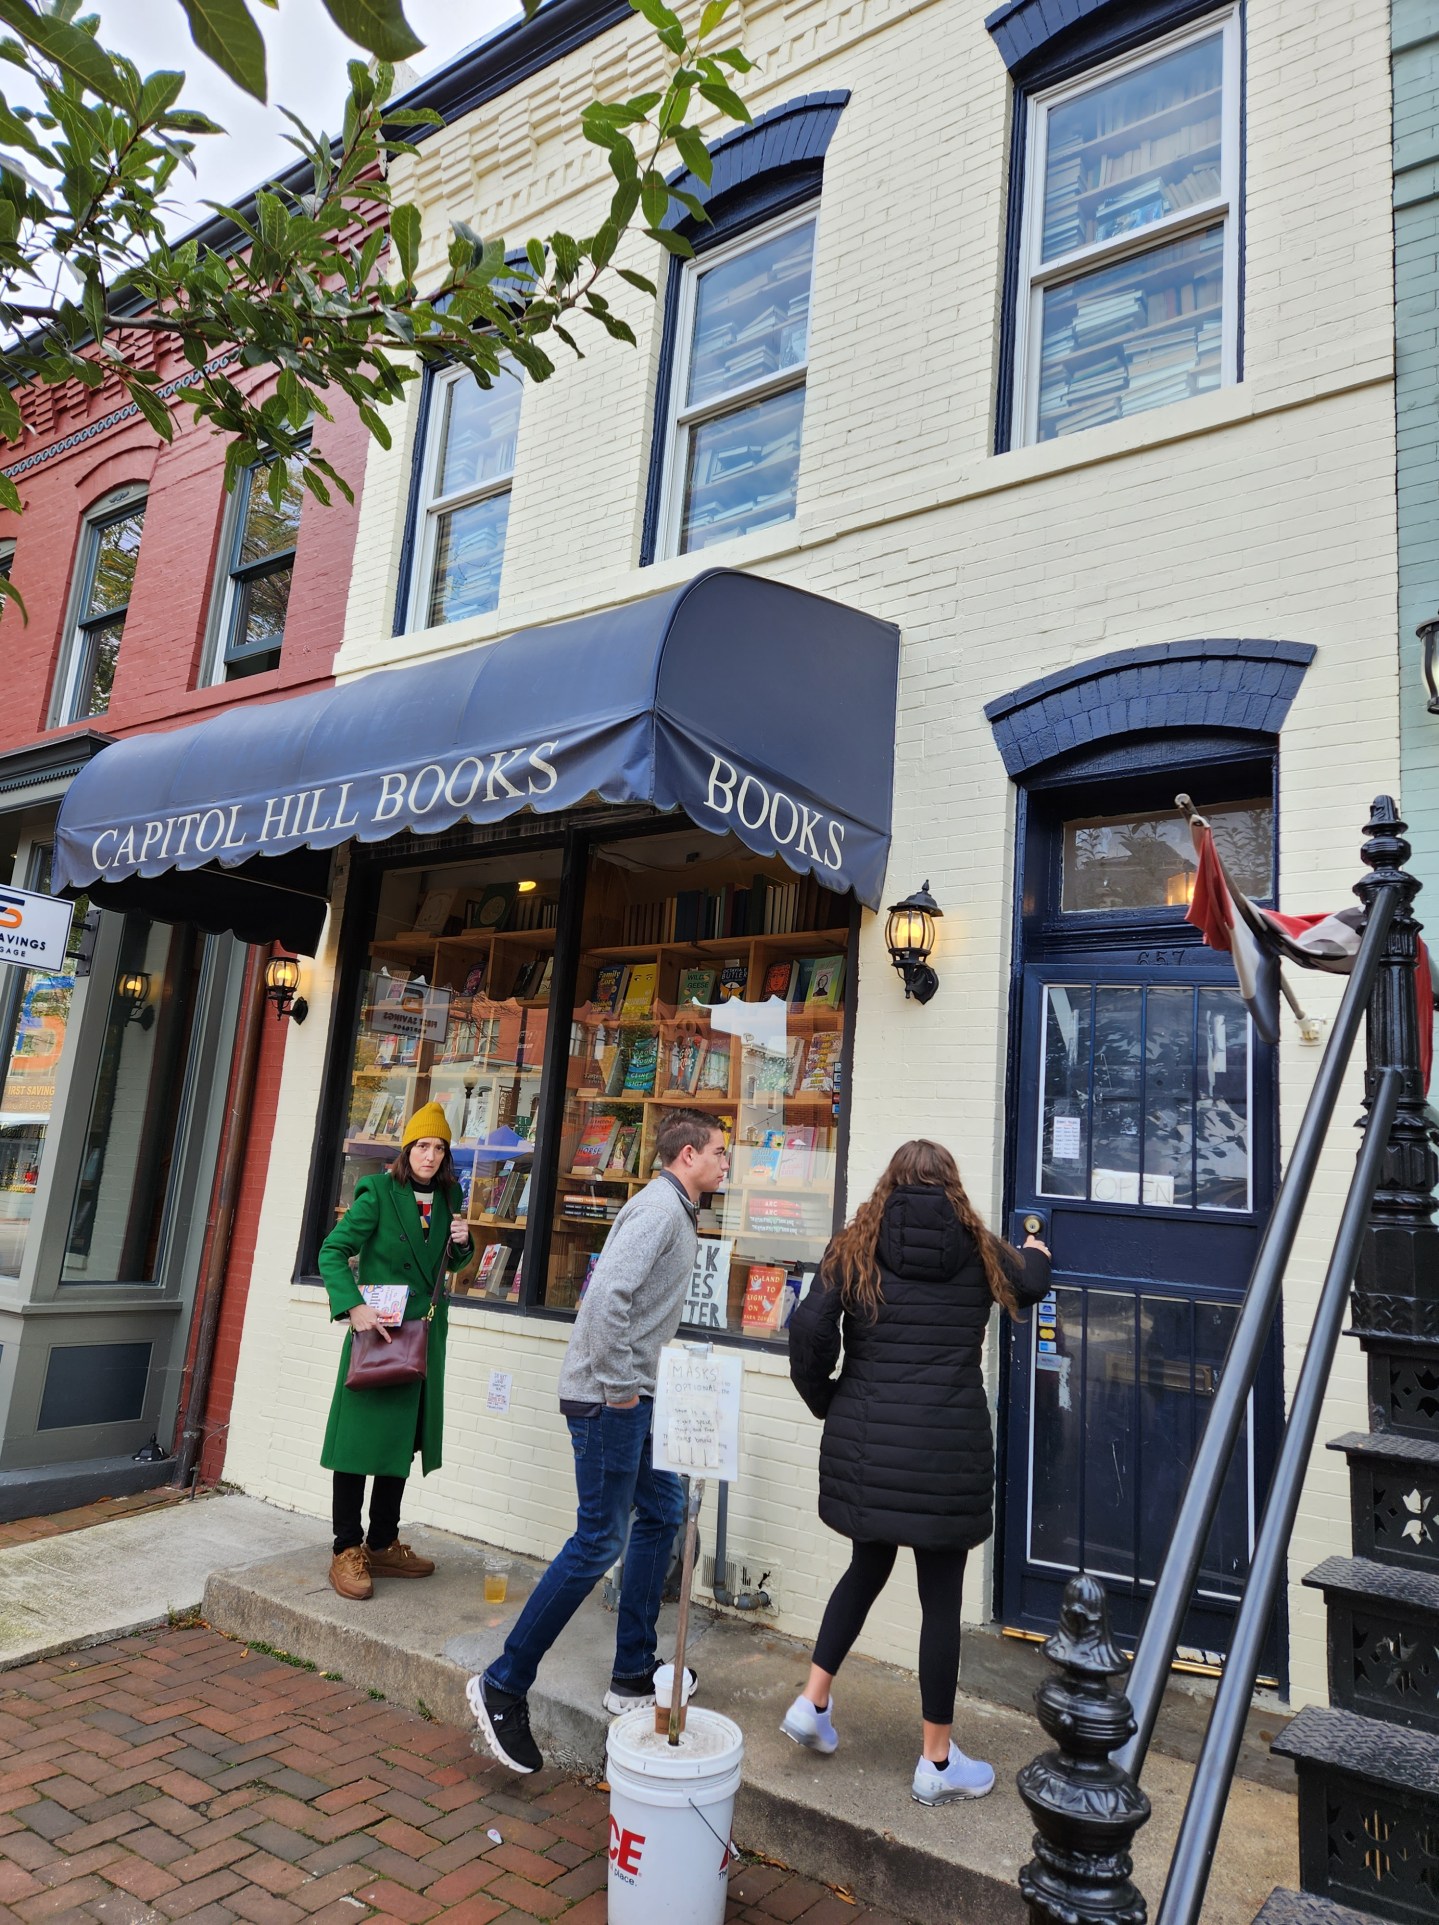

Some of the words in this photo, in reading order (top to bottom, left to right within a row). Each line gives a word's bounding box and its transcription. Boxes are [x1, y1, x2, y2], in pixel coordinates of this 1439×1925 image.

[91, 804, 246, 871] CAPITOL
[263, 782, 360, 841] HILL
[371, 739, 561, 823] BOOKS
[703, 752, 845, 871] BOOKS
[0, 932, 46, 951] AVINGS
[1137, 949, 1186, 966] 657
[599, 969, 621, 979] Family
[7, 1085, 26, 1096] IRST
[26, 1085, 55, 1096] SAVING
[578, 1146, 602, 1155] HORSE
[694, 1243, 720, 1272] CK
[691, 1272, 714, 1299] ES
[762, 1275, 780, 1283] LAND
[685, 1299, 720, 1327] TER
[672, 1366, 717, 1381] MASKS
[674, 1383, 717, 1392] OPTIONAL
[608, 1814, 645, 1876] CE
